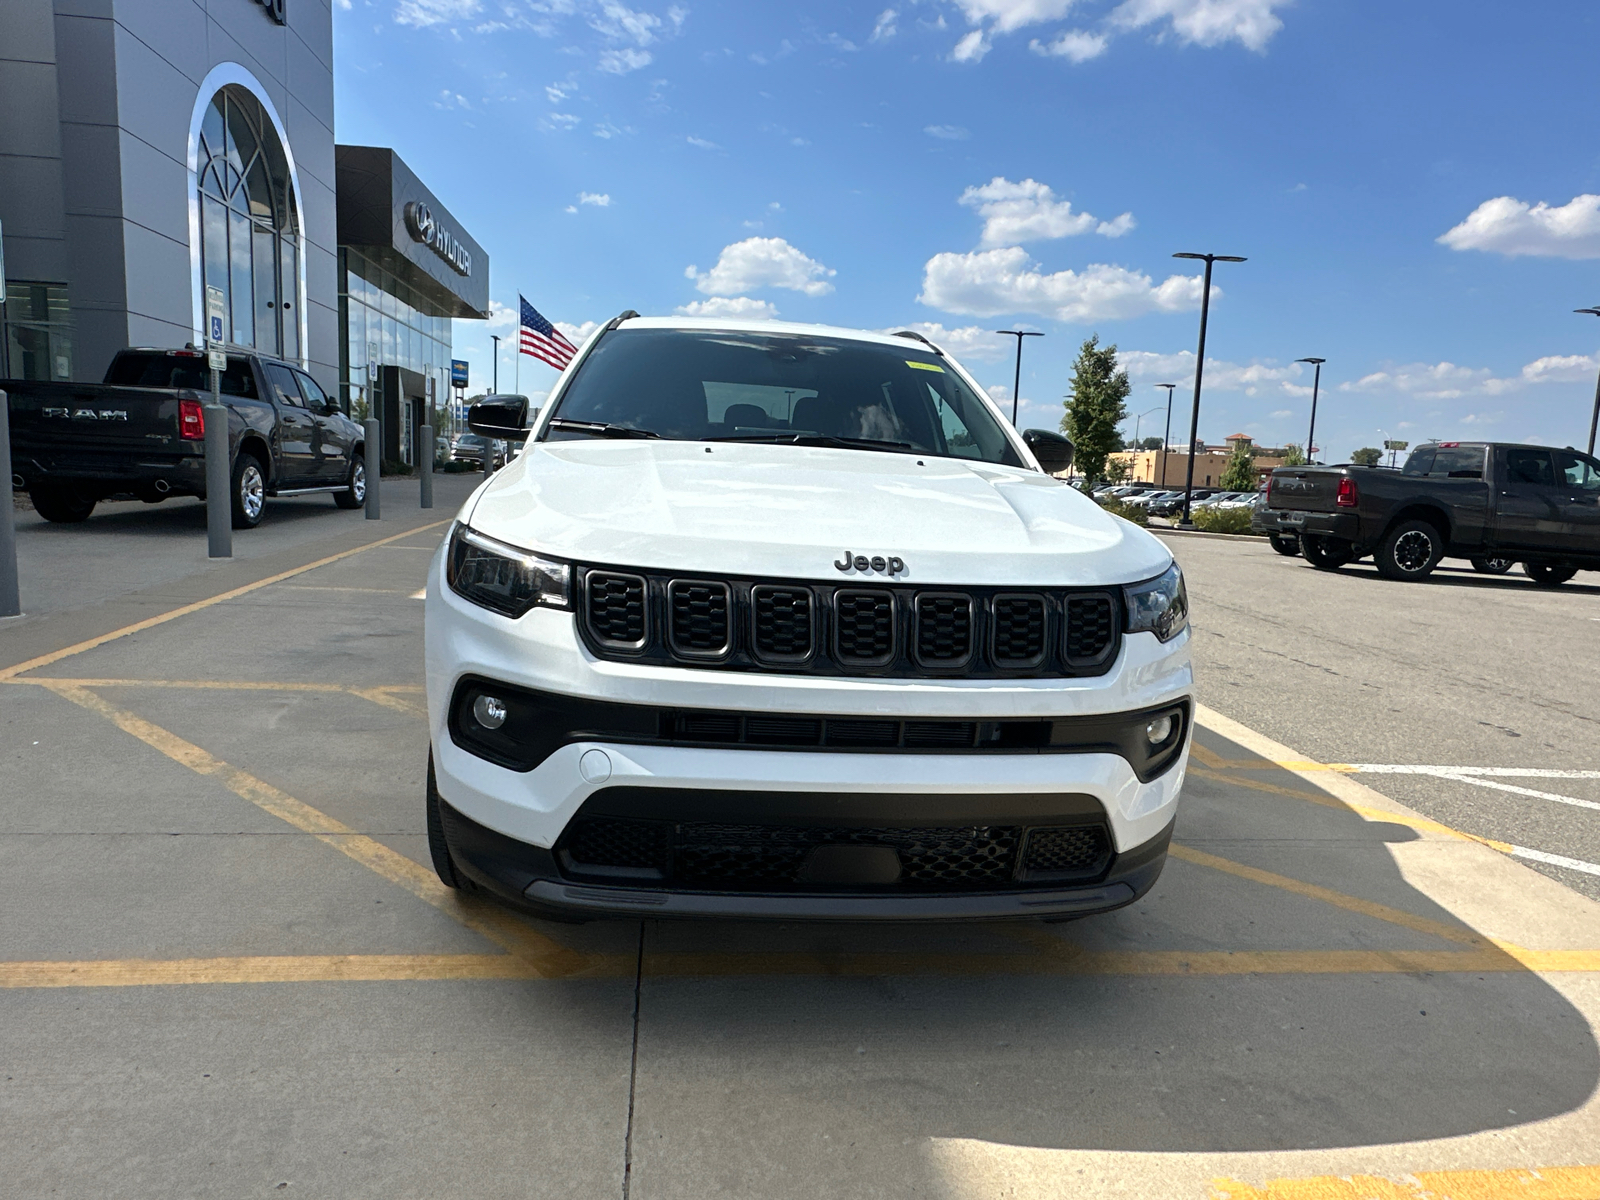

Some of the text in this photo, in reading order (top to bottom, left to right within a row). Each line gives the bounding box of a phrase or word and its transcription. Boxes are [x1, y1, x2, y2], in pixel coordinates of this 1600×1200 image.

[436, 221, 472, 277] HYUNDAI
[42, 406, 127, 421] RAM
[834, 551, 904, 576] Jeep
